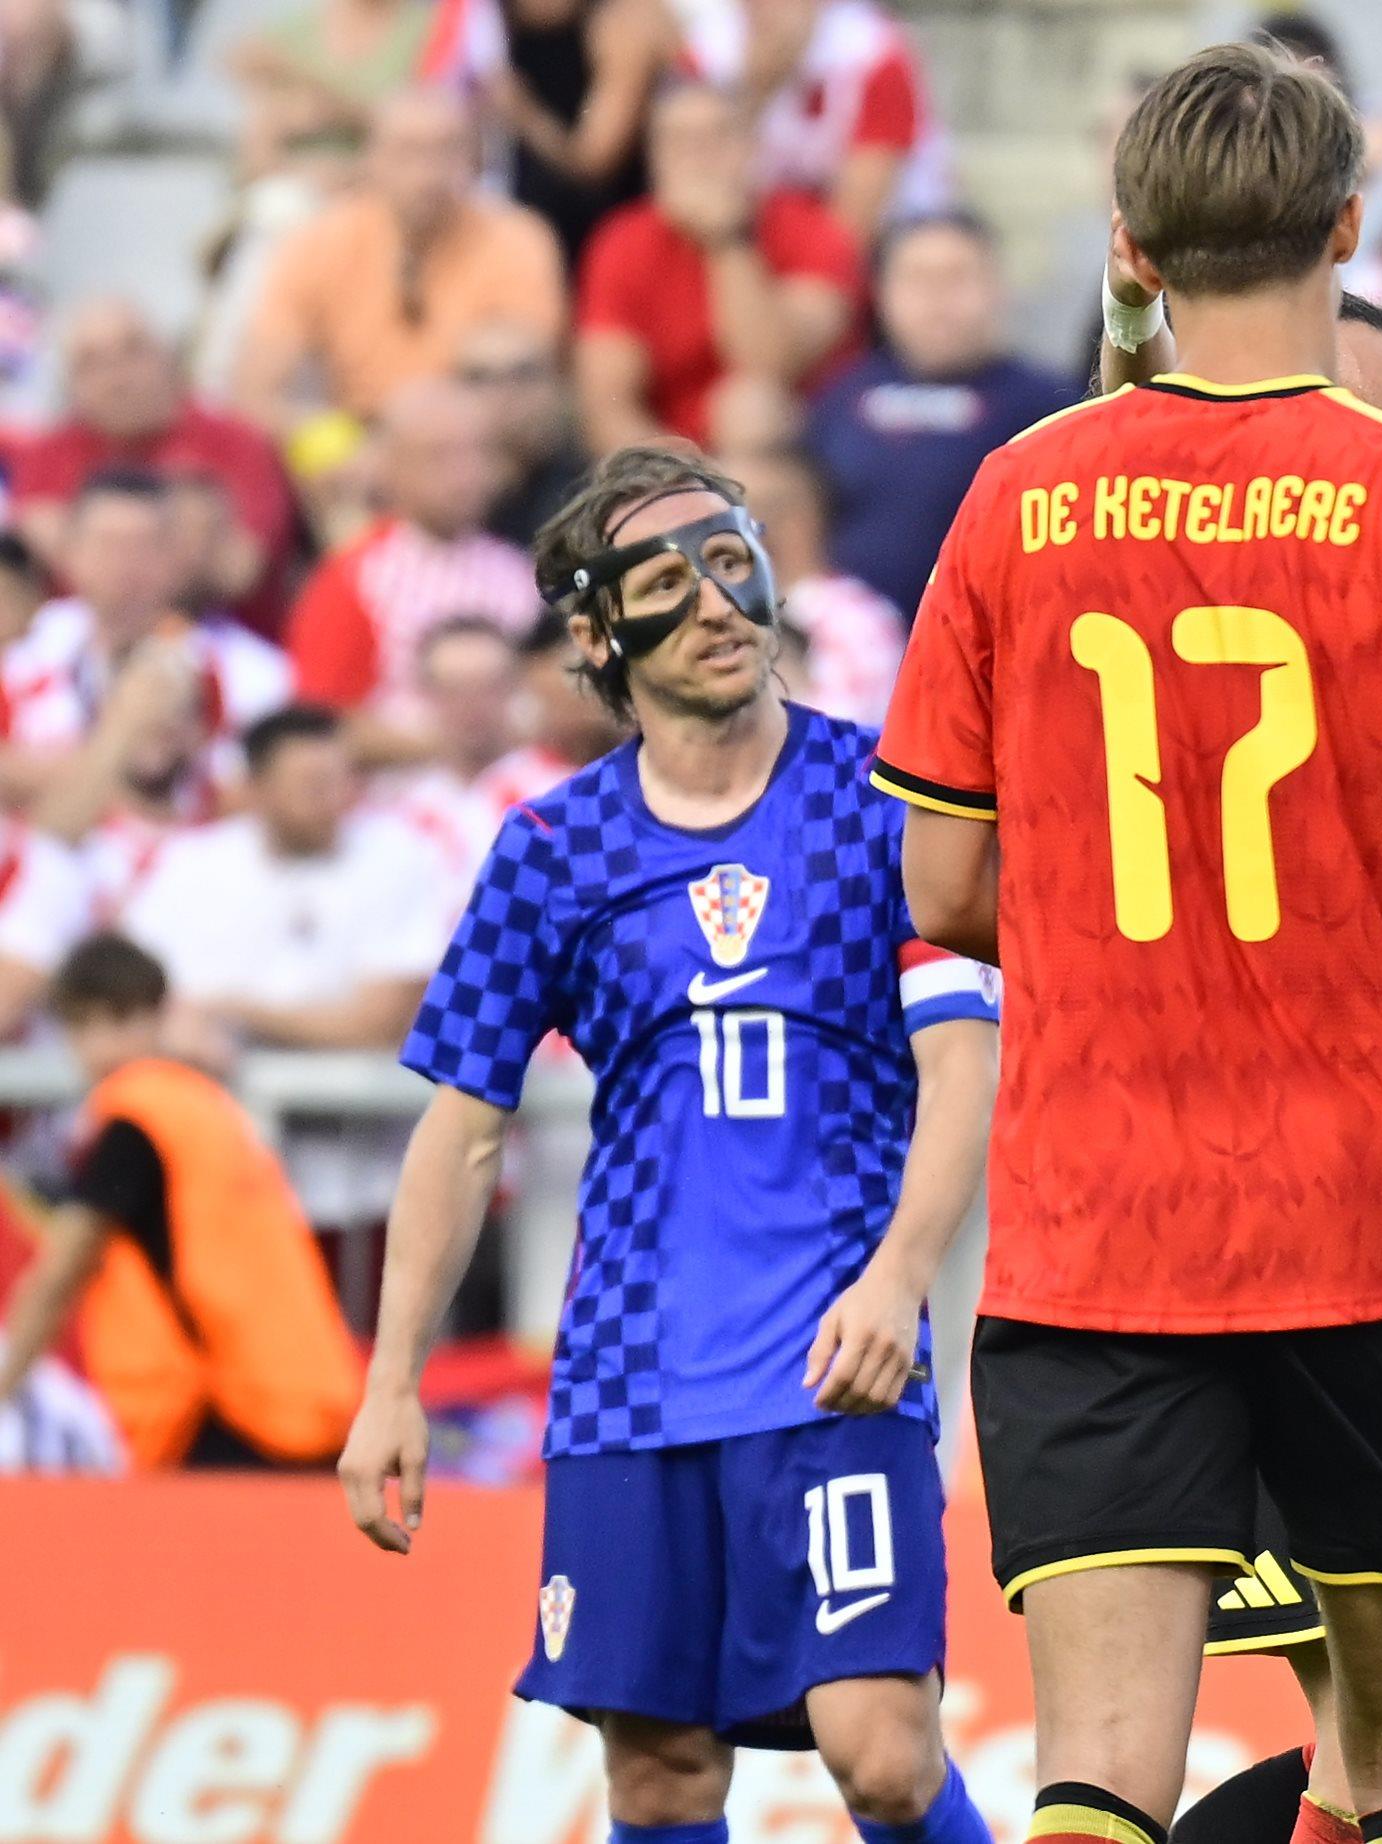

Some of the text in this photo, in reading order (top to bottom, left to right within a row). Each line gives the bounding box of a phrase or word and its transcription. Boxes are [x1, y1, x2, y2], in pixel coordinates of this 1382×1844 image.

[1021, 475, 1368, 554] DE KETELAERE
[1070, 605, 1317, 942] 17
[690, 1010, 785, 1118] 10
[804, 1473, 894, 1597] 10
